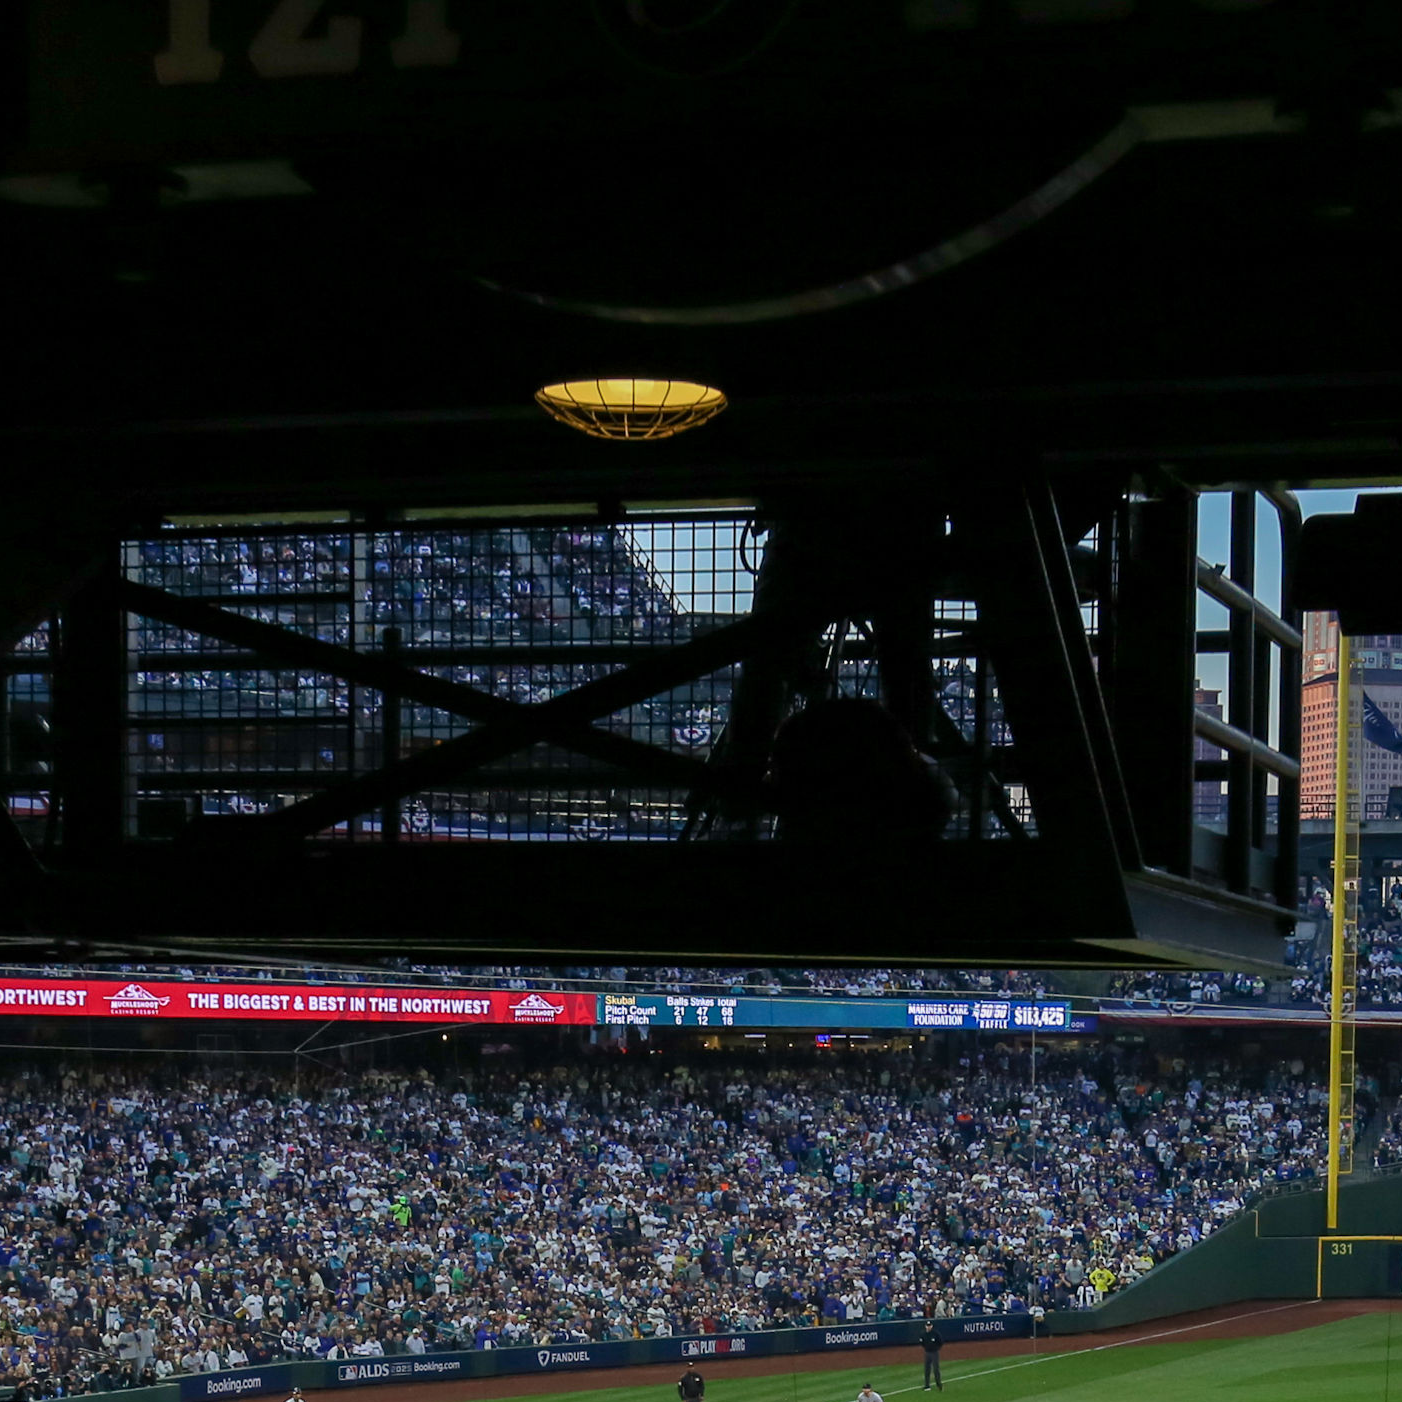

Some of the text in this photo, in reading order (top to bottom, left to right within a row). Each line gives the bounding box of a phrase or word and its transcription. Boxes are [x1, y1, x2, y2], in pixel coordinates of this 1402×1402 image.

[110, 1000, 159, 1009] MUCKLESHOOT
[188, 993, 490, 1015] THE BIGGEST & BEST IN THE NORTHWEST
[604, 996, 636, 1006] Skubal
[666, 997, 689, 1007] Balls
[605, 1006, 733, 1016] Pitch Count 21 47 68
[907, 1004, 947, 1015] MARINERS
[948, 1004, 969, 1015] CARE
[605, 1015, 733, 1025] First Pitch 6 12 18
[914, 1014, 963, 1025] FOUNDATION
[979, 1020, 1008, 1029] RAFFLE
[1331, 1243, 1353, 1255] 331
[964, 1320, 1005, 1333] NUTRAFOL
[825, 1330, 878, 1346] Booking.com
[551, 1350, 590, 1363] FANDUEL
[358, 1363, 390, 1379] ALDS
[414, 1360, 460, 1374] Booking.com
[207, 1376, 262, 1395] Booking.com
